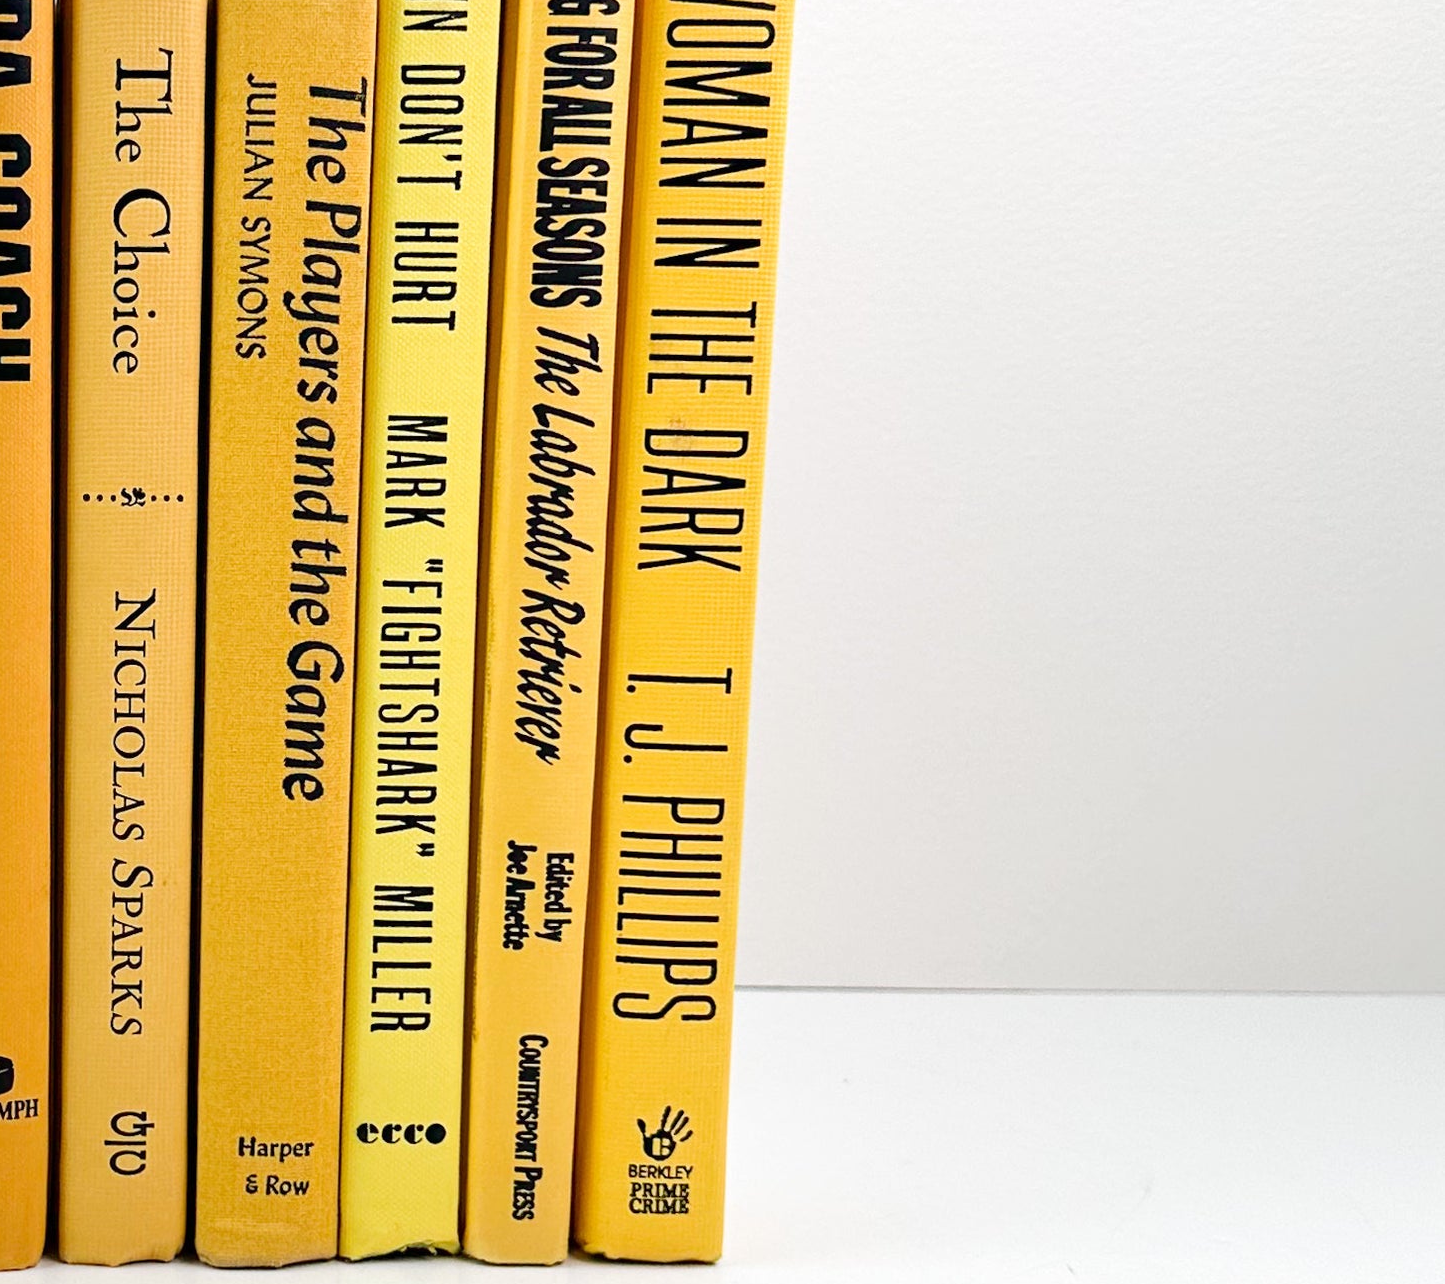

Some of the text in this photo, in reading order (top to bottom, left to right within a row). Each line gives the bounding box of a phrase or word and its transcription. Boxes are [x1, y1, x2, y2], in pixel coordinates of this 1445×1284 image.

[543, 27, 617, 90] FOR
[397, 65, 466, 190] DON'T
[540, 95, 613, 152] ALL
[113, 48, 173, 373] The Choice
[236, 73, 276, 358] JULIAN SYMONS
[530, 157, 610, 308] SEASONS
[654, 218, 762, 268] IN
[392, 222, 459, 330] HURT
[647, 302, 757, 395] THE
[282, 77, 367, 801] The Players and the Game
[515, 327, 602, 765] The Labrador Retriever
[638, 429, 749, 571] DARK
[371, 415, 448, 1032] MARK "FIGHTSHARK" MILLER
[111, 589, 156, 1034] NICHOLAS SPARKS
[503, 840, 537, 950] Joe Arnette
[535, 853, 574, 942] Edited by
[613, 795, 724, 1021] PHILLIPS
[239, 1137, 314, 1162] Harper
[246, 1174, 309, 1195] & Row
[357, 1123, 446, 1144] ecco
[629, 1164, 692, 1179] BERKLEY
[629, 1182, 690, 1198] PRIME
[629, 1198, 690, 1214] CRIME
